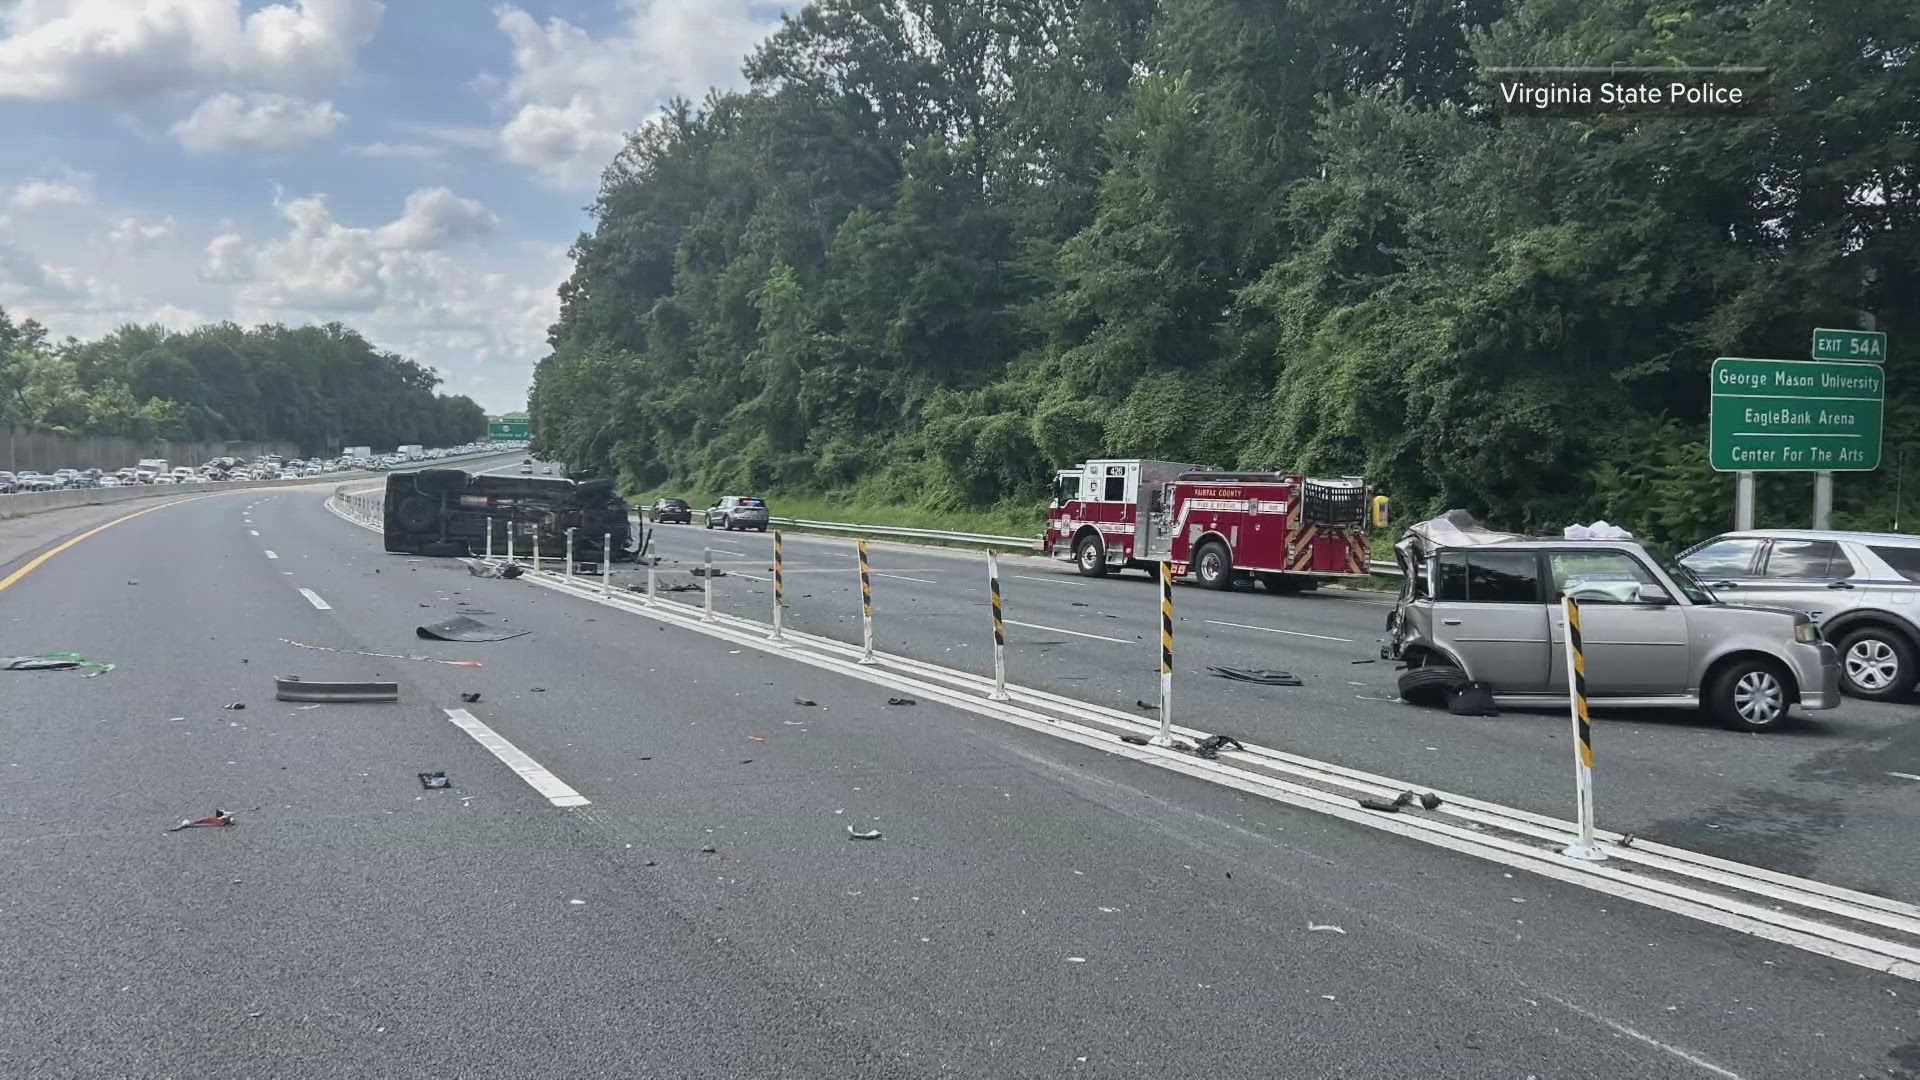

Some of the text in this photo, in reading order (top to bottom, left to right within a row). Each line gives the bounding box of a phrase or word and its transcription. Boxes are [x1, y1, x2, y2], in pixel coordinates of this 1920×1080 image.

[1818, 337, 1881, 356] EXIT 54A
[1719, 368, 1880, 393] George Mason University
[1745, 408, 1855, 426] EagleBank Arena
[1731, 446, 1864, 462] Center For The Arts
[1110, 466, 1123, 476] 426
[1194, 488, 1242, 498] FAIRFAX COUNTY
